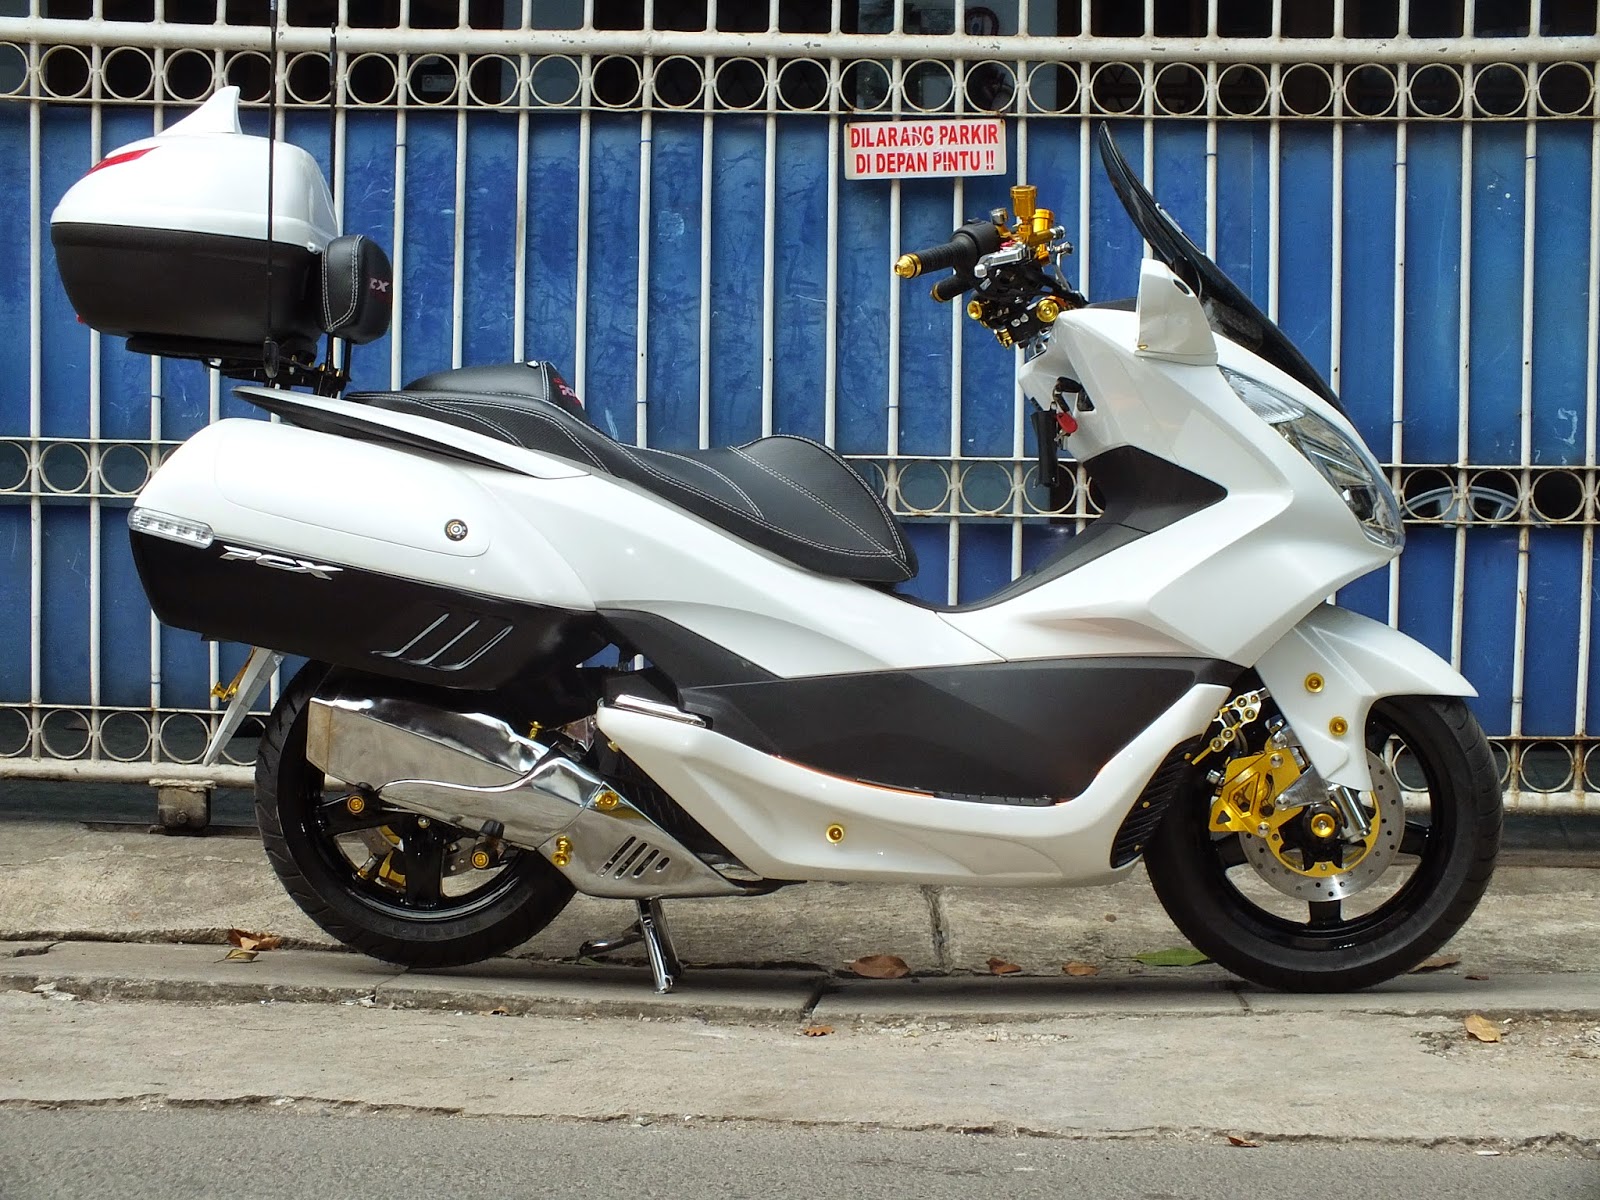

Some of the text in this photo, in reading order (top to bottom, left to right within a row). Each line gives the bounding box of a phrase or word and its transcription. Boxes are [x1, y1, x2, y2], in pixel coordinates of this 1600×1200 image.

[851, 124, 998, 148] DILARANG PARKIR
[856, 154, 871, 174] DI
[876, 152, 928, 173] DEPAN
[933, 151, 981, 172] PINTU
